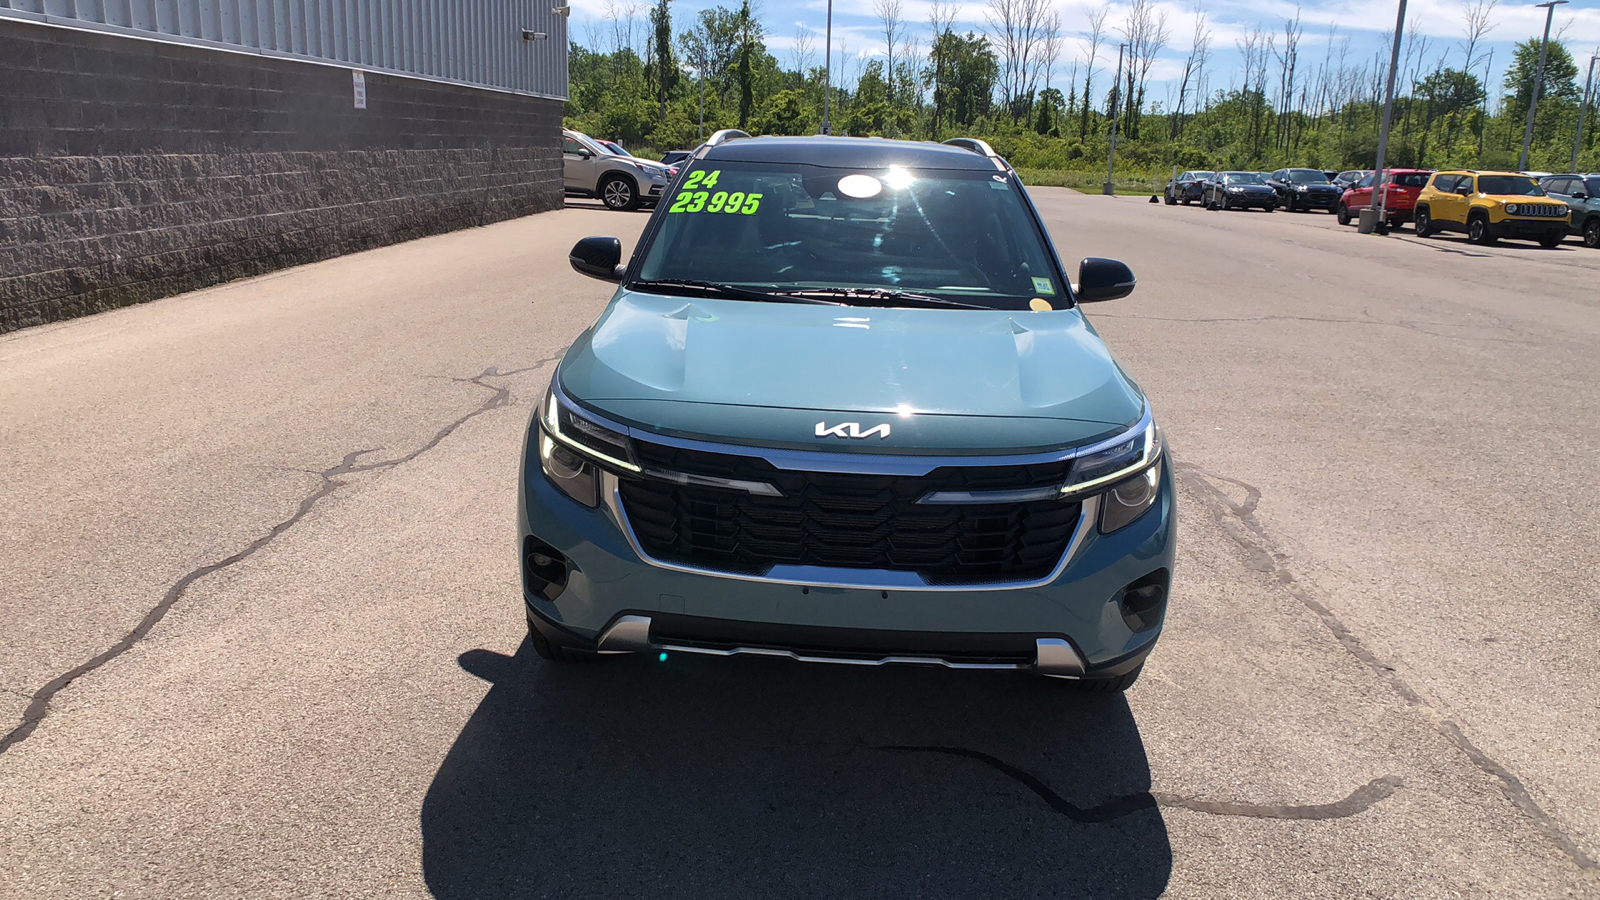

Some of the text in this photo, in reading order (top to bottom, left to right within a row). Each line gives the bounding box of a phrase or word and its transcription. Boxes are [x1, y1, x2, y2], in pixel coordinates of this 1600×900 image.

[682, 170, 721, 189] 24
[668, 191, 763, 215] 23995
[814, 421, 891, 439] KIA
